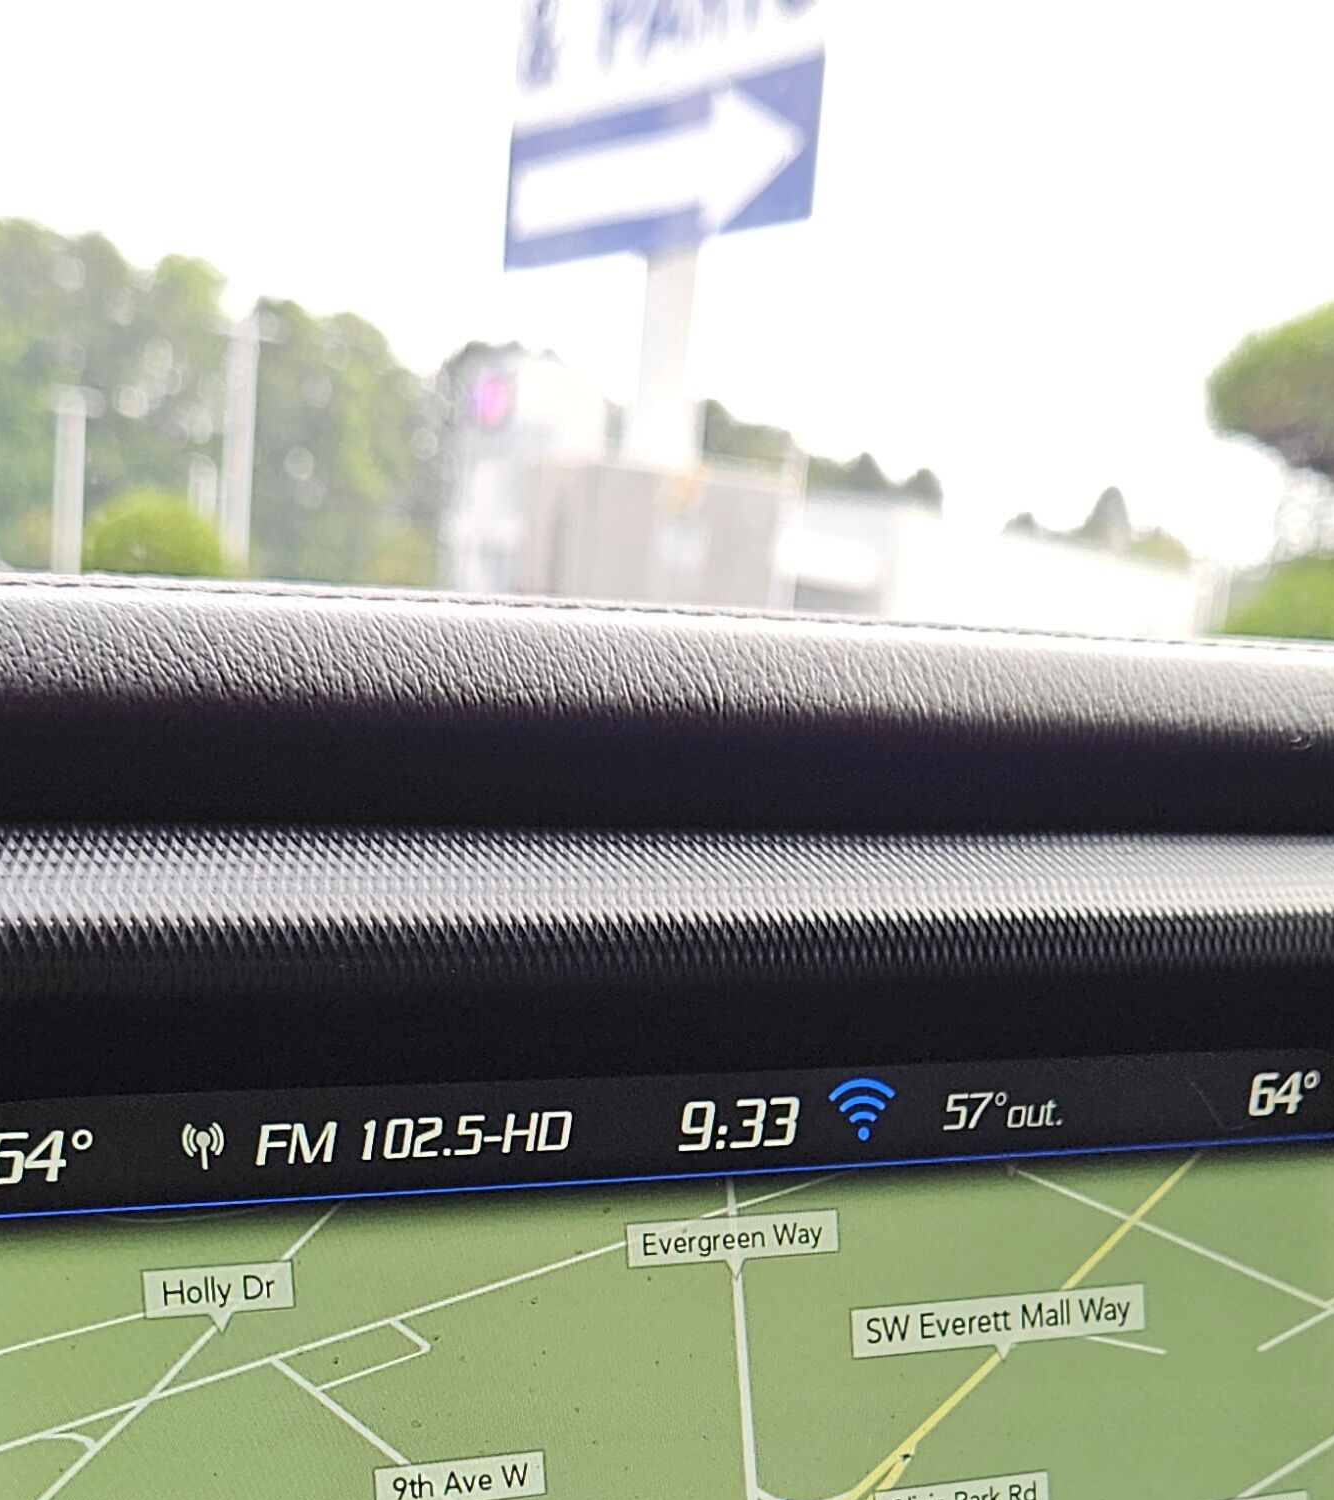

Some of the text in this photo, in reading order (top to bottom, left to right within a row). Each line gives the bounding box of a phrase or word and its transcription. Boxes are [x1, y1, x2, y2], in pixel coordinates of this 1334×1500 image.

[1248, 1070, 1321, 1117] 64°
[256, 1111, 573, 1167] FM 102.5-HD
[678, 1096, 801, 1151] 9:33
[642, 1221, 823, 1257] Evergreen Way
[162, 1274, 276, 1308] Holly Dr
[866, 1297, 1131, 1345] SW Everett Mall Way
[444, 1470, 493, 1495] Ave
[501, 1463, 528, 1488] W
